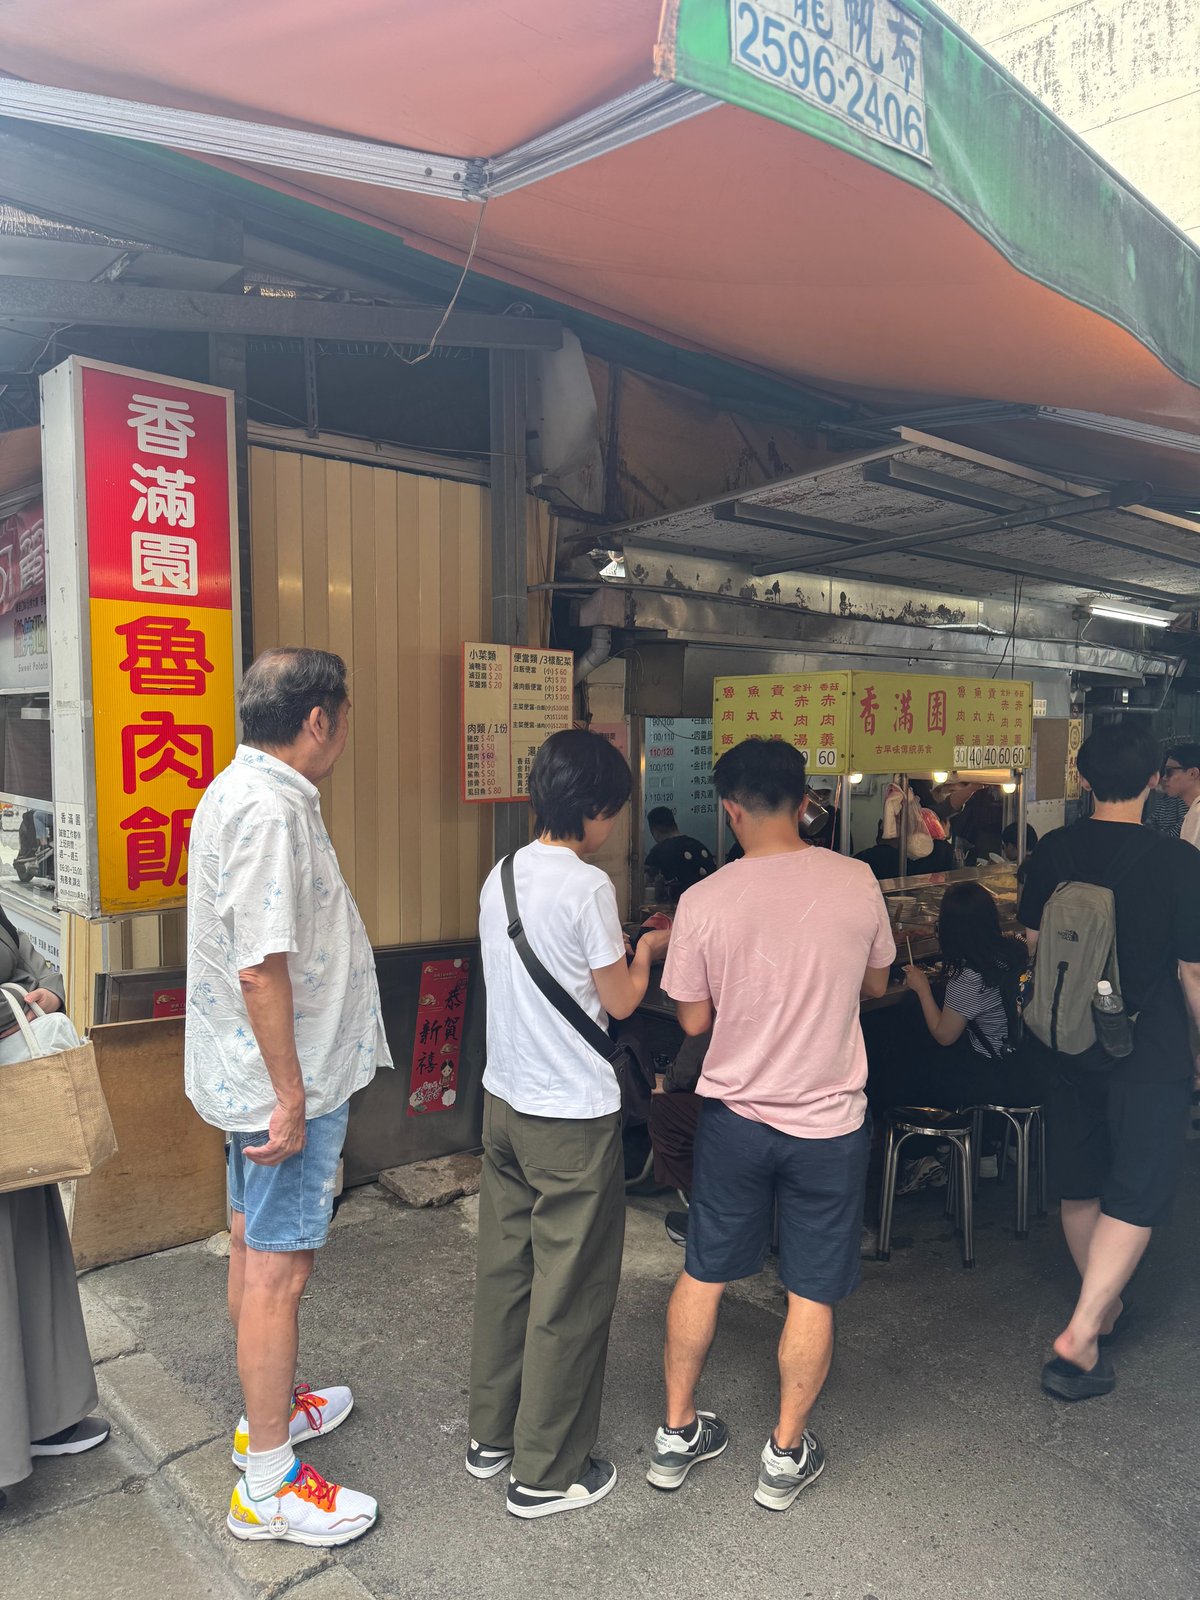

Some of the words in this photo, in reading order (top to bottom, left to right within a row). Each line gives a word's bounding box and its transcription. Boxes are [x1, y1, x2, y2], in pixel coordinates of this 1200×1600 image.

[127, 393, 199, 596] 香滿園
[469, 649, 497, 661] 小菜類
[722, 686, 735, 745] 魯肉飯
[115, 615, 215, 892] 魯肉飯
[818, 749, 836, 766] 60
[969, 748, 981, 766] 40
[984, 747, 996, 766] 40
[999, 747, 1010, 764] 60
[1012, 747, 1024, 764] 60
[444, 985, 464, 1042] 恭賀
[416, 1019, 443, 1076] 新禧
